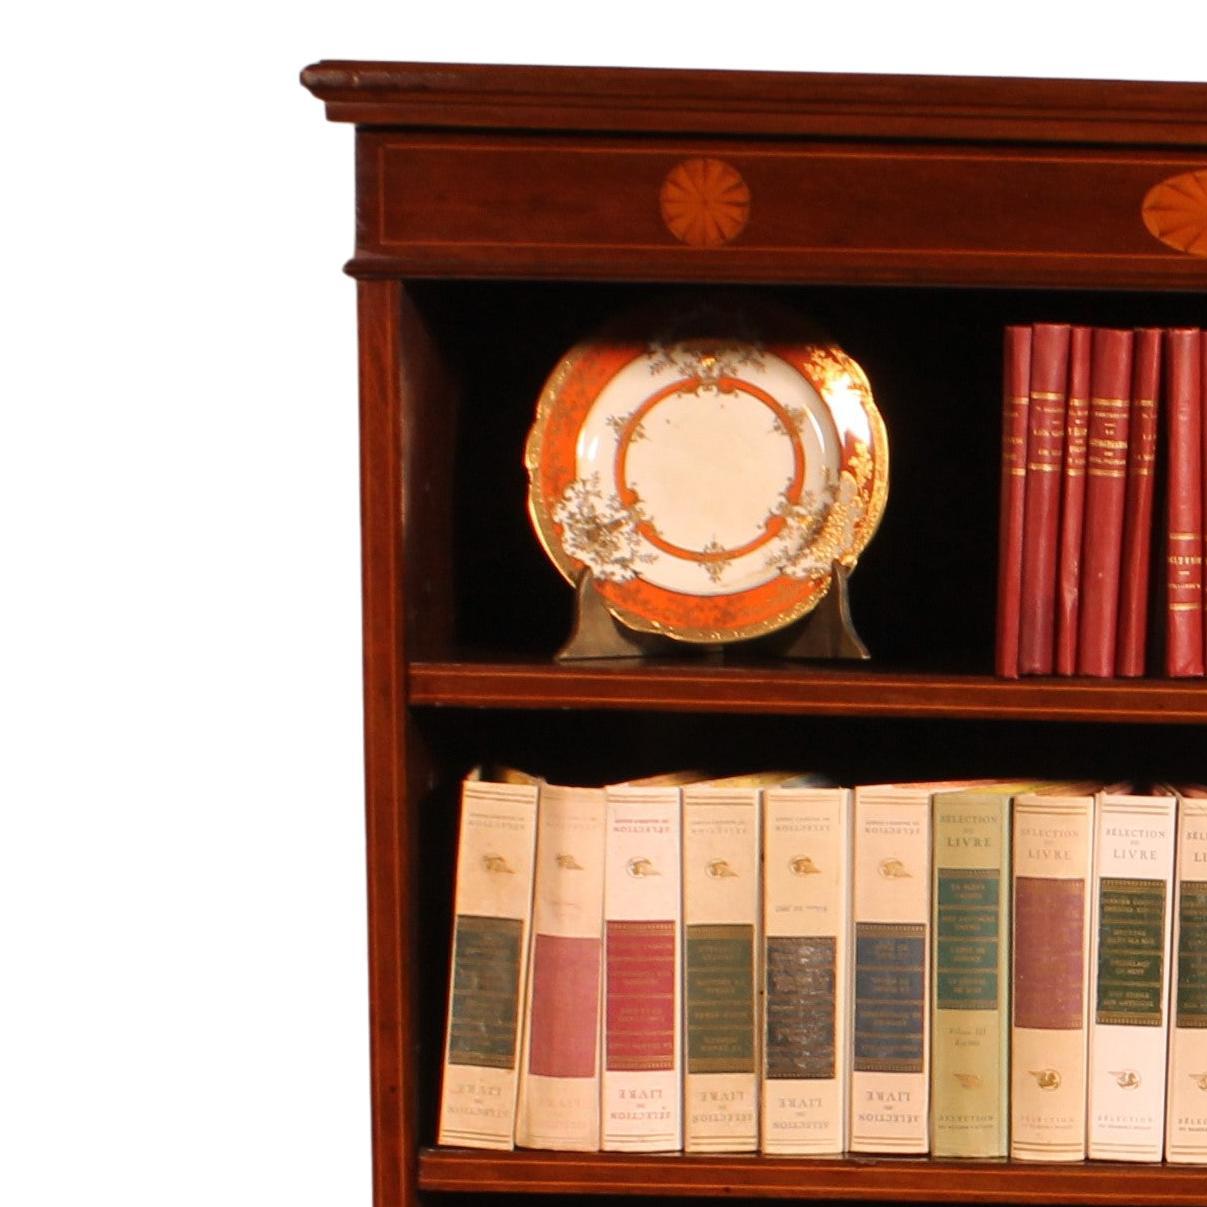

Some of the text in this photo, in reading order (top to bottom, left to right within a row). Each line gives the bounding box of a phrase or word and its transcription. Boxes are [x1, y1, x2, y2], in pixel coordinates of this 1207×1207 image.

[947, 837, 991, 847] LIVRE
[1029, 850, 1071, 860] LIVRE
[1113, 849, 1157, 860] LIVRE
[618, 1089, 662, 1099] LIVRE
[700, 1091, 744, 1102] LIVRE
[866, 1091, 911, 1102] LIVRE
[778, 1098, 822, 1108] LIVRE
